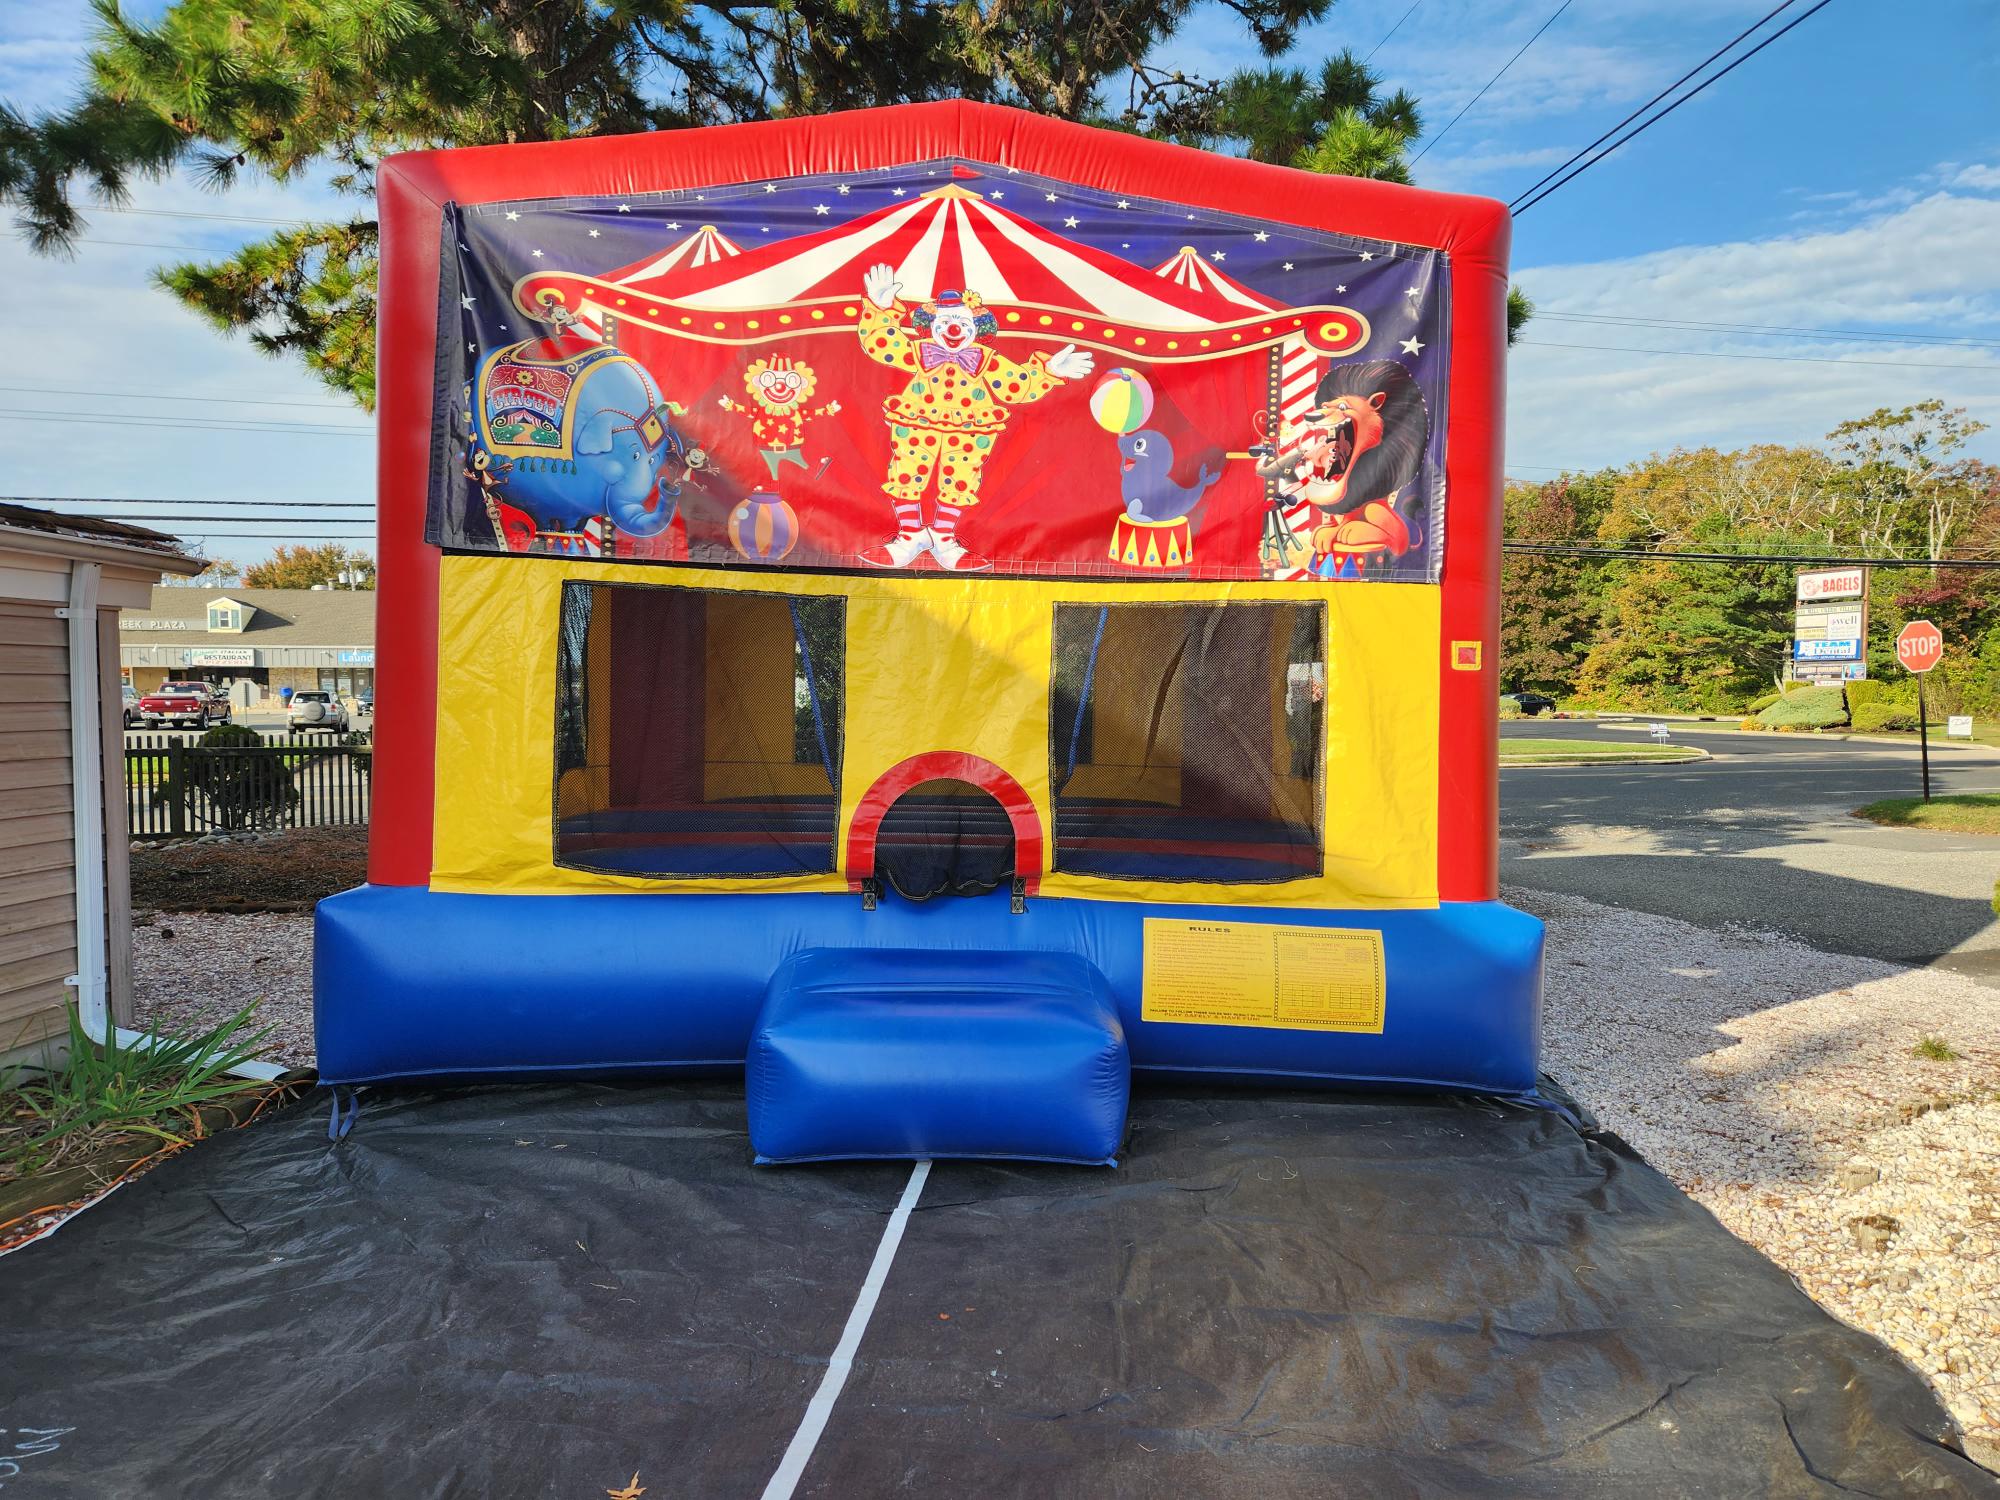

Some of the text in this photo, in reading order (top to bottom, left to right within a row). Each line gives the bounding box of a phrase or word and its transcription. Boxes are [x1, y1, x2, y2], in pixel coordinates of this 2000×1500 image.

[492, 386, 557, 417] CIRCUS
[1822, 576, 1860, 593] BAGELS
[150, 620, 187, 630] PLAZA
[1901, 635, 1939, 658] STOP
